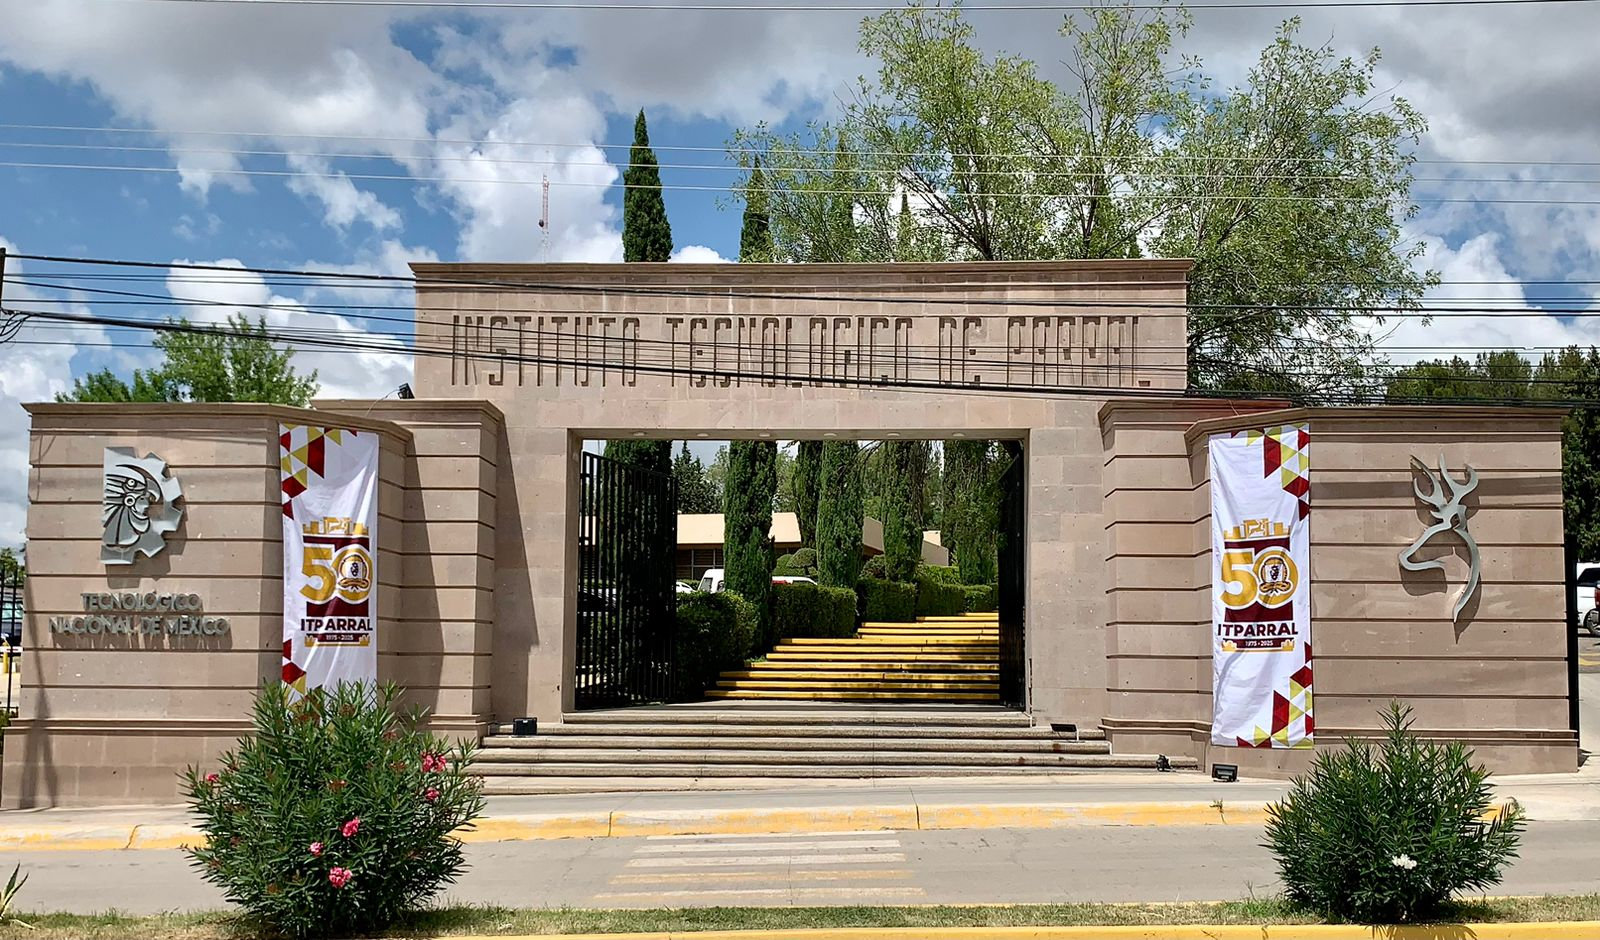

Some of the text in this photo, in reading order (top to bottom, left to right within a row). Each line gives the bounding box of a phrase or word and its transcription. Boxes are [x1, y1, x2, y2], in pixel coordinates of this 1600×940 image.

[452, 315, 1152, 389] INSTITUTO TECNOLOGICO DE PARRAL
[80, 590, 202, 611] TECNOLÓGICO
[300, 546, 373, 601] 50
[1220, 550, 1299, 606] 50
[49, 615, 137, 635] NACIONAL
[140, 616, 161, 635] DE
